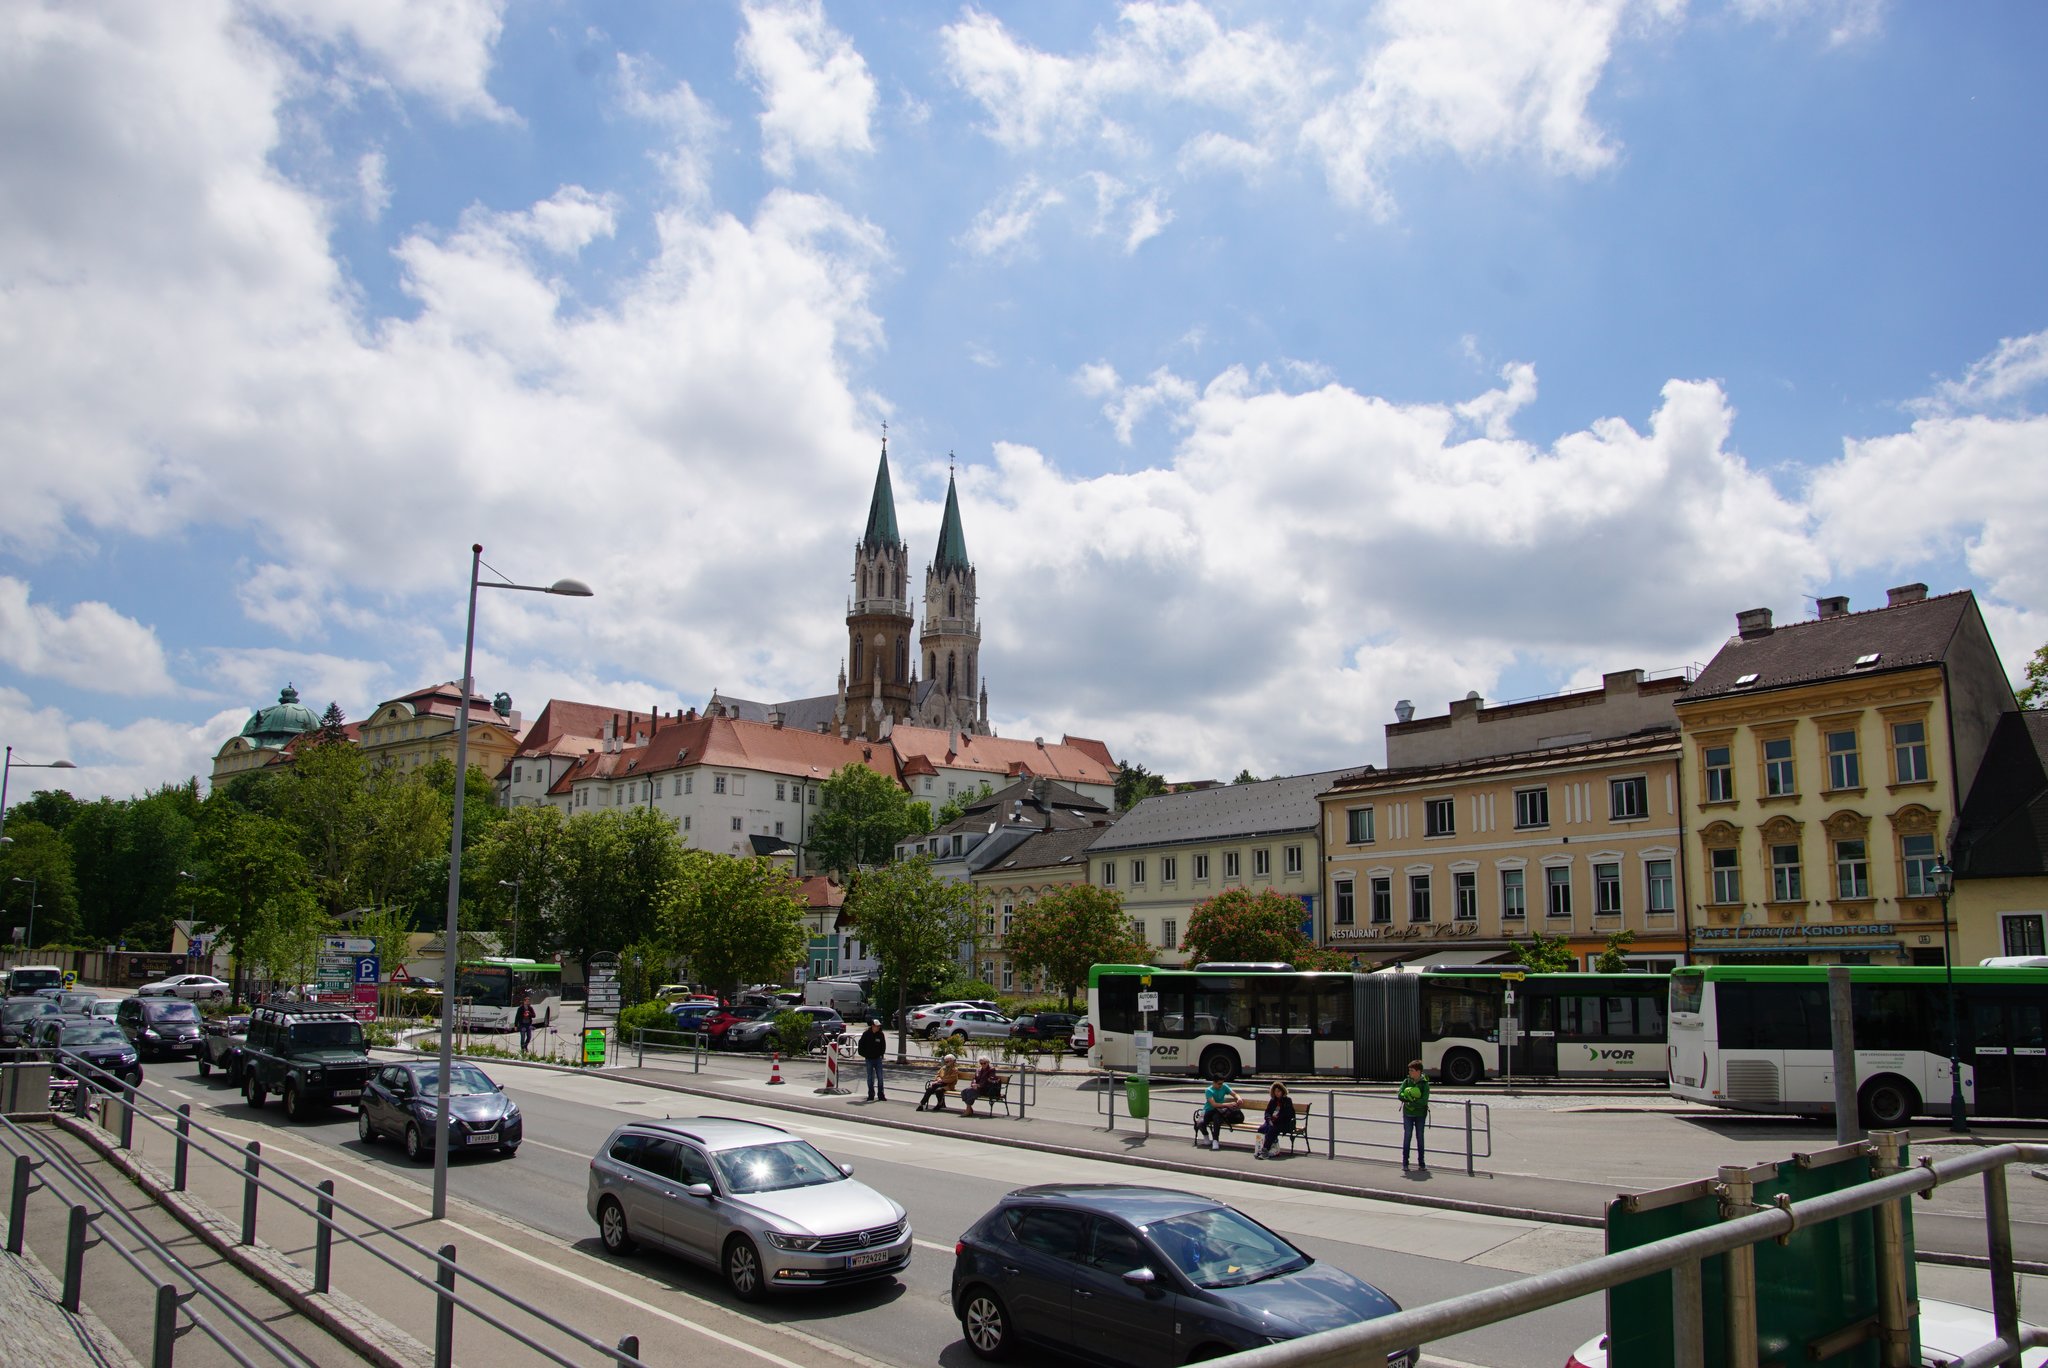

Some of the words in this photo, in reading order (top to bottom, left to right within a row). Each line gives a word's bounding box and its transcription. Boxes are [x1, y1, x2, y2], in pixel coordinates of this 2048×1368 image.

[1331, 928, 1379, 939] RESTAURANT
[1801, 924, 1894, 937] KONDITOREI
[1600, 1049, 1635, 1059] VOR
